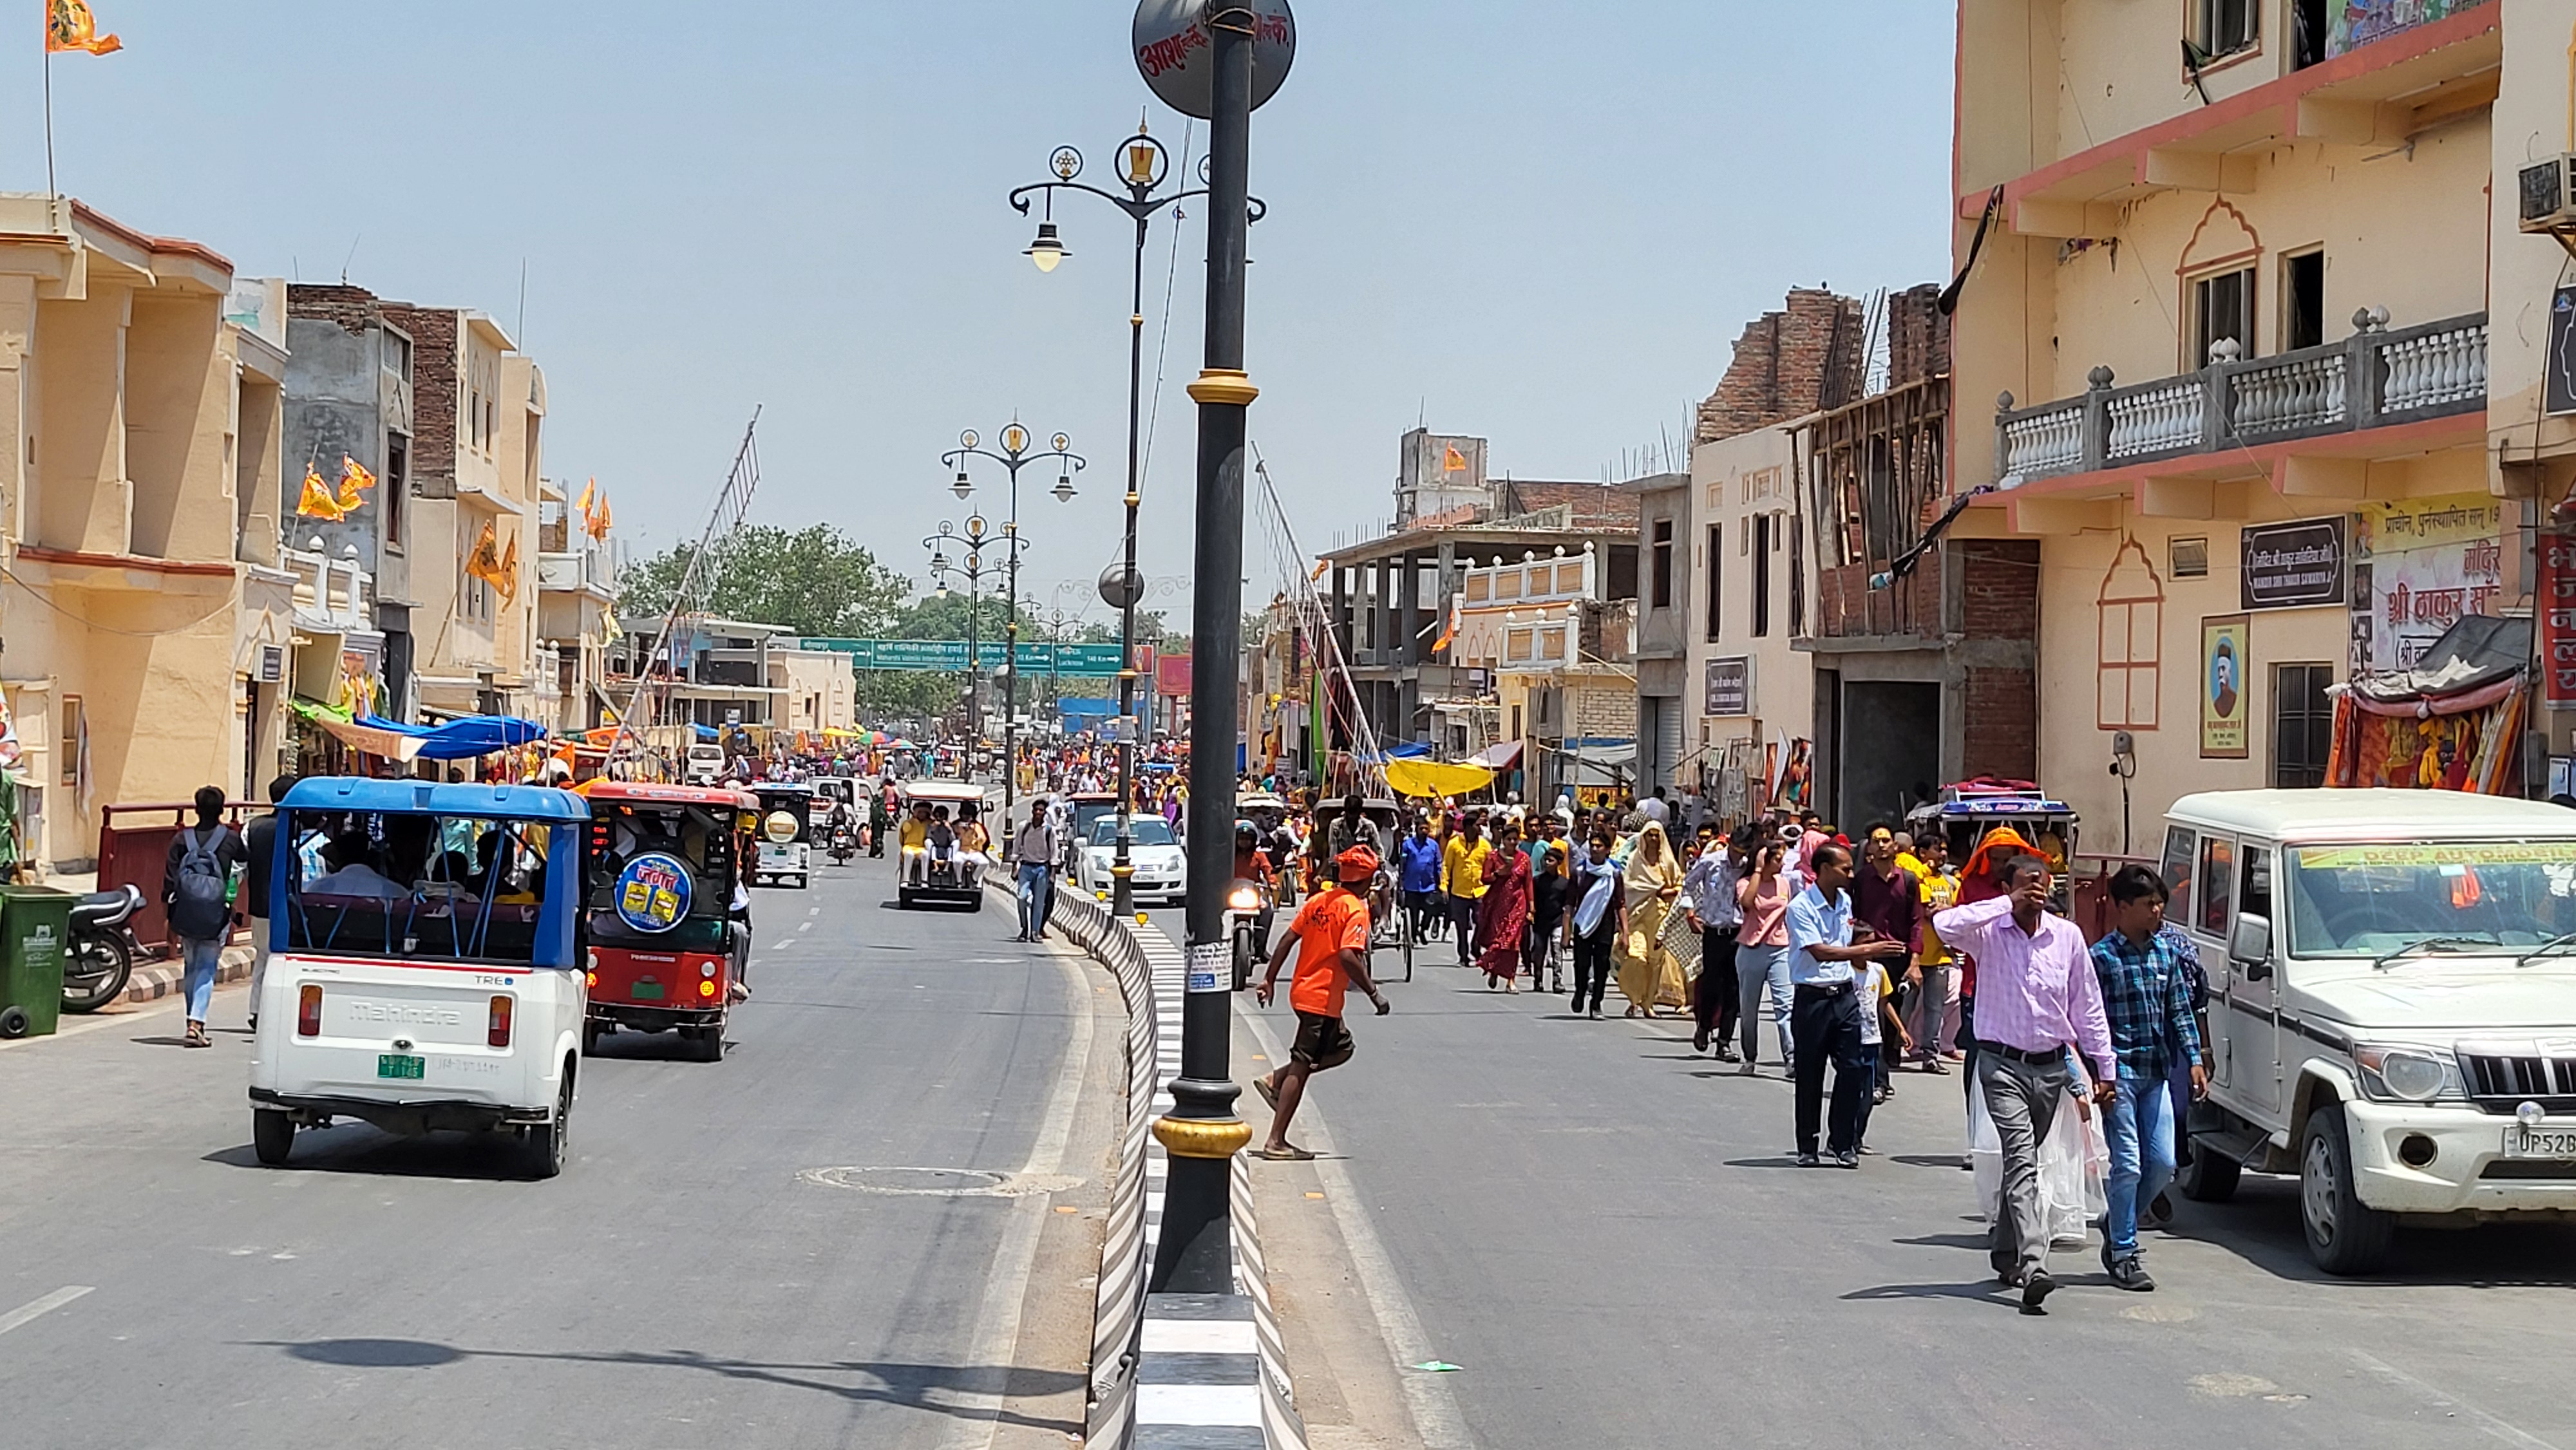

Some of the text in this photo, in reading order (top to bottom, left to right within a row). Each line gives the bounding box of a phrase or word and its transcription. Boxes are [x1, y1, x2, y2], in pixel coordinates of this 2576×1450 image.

[2388, 582, 2410, 625] श्री
[2415, 587, 2467, 627] ठाकुर
[2435, 847, 2576, 860] AUTOMOBIL
